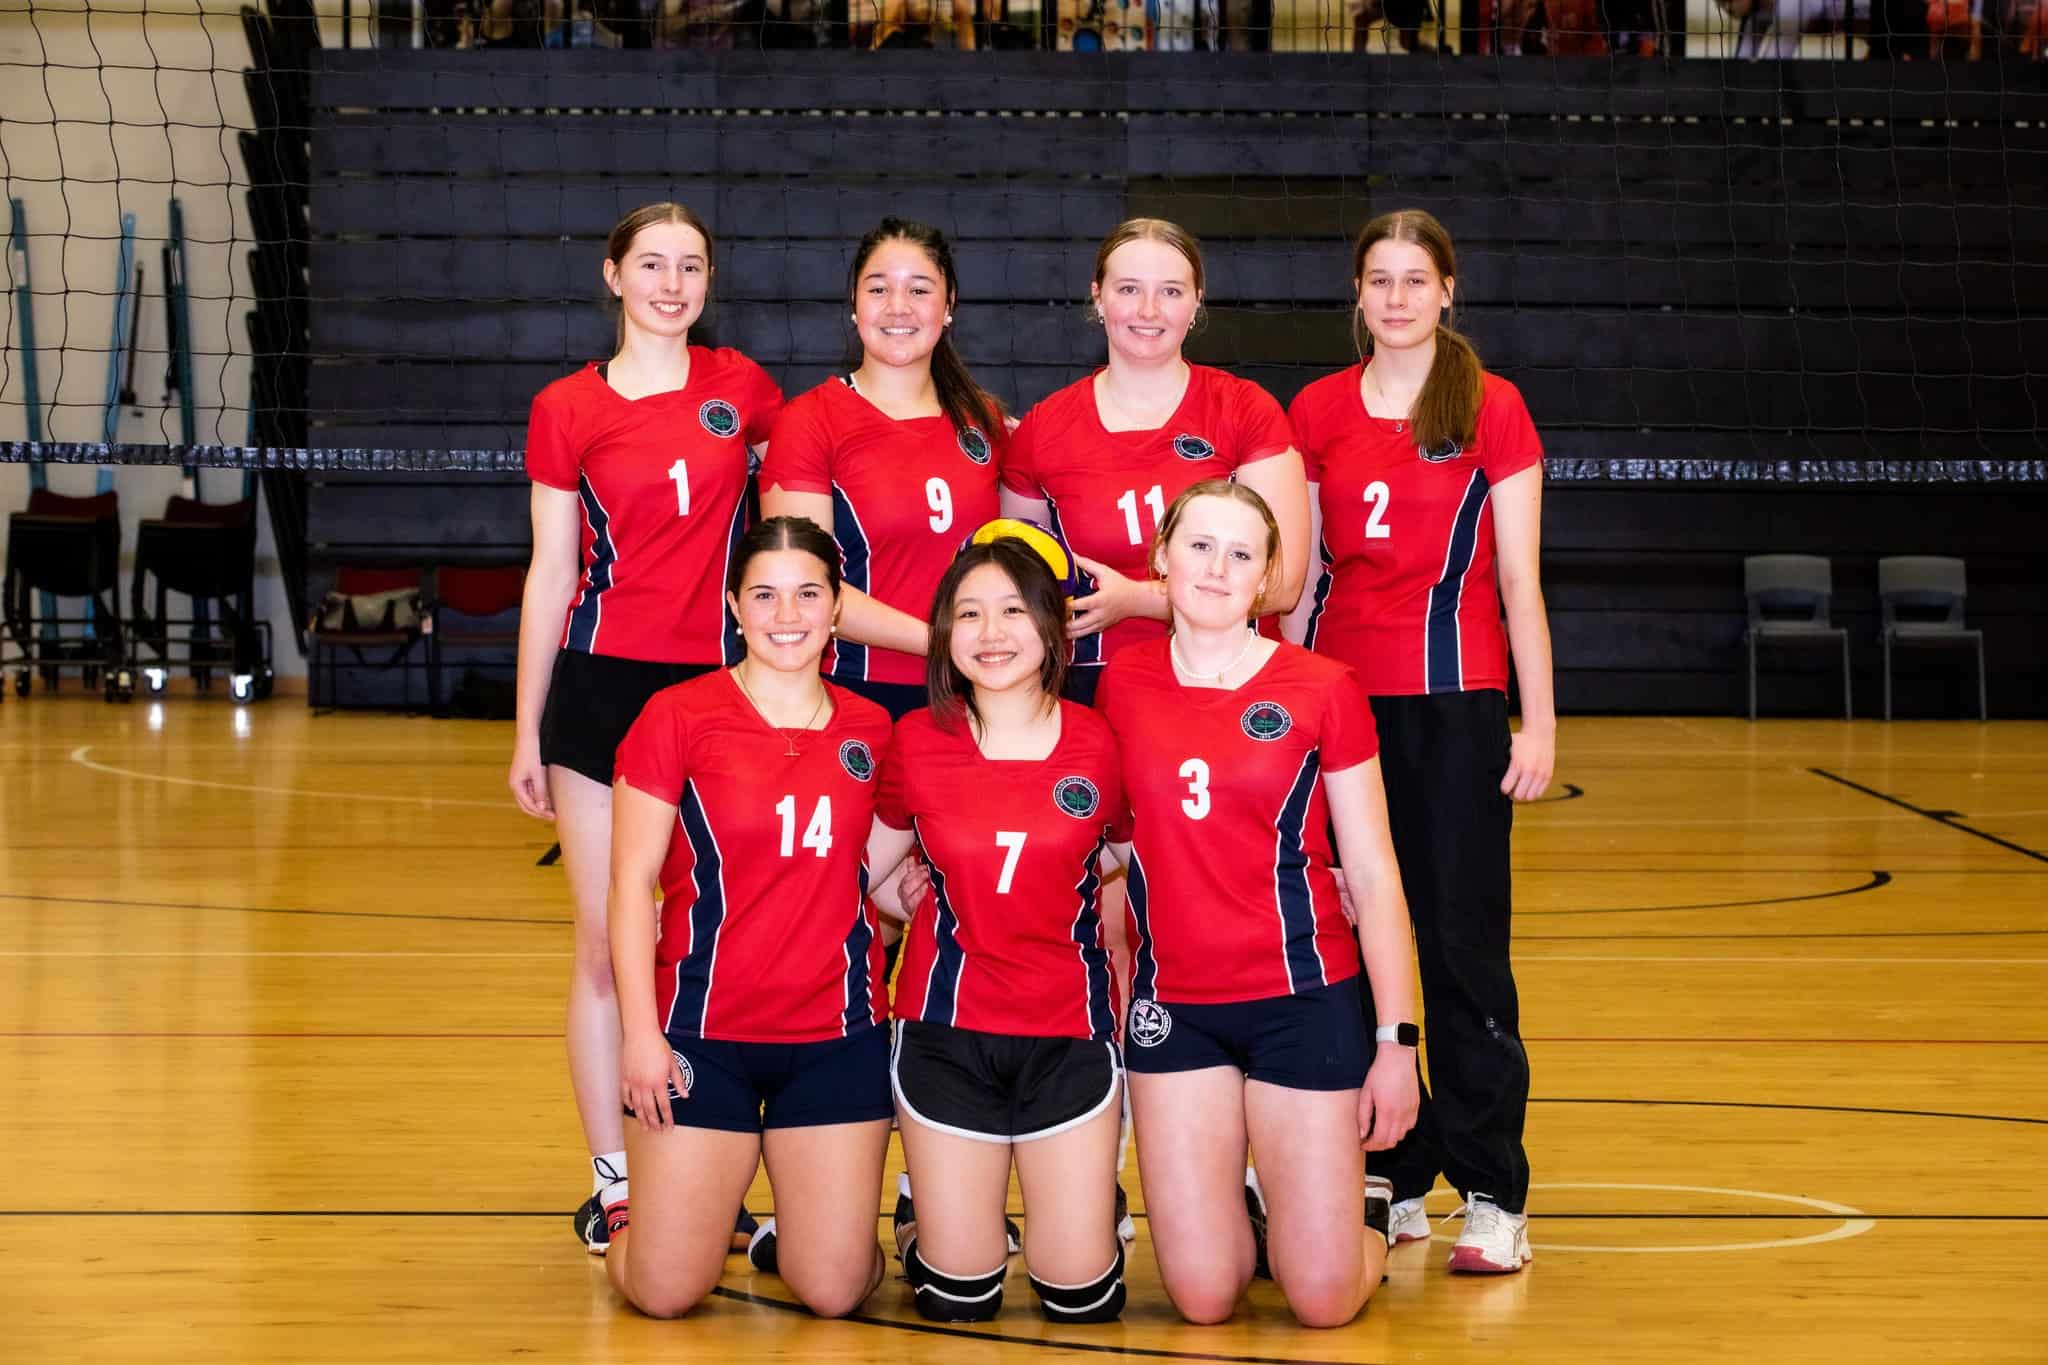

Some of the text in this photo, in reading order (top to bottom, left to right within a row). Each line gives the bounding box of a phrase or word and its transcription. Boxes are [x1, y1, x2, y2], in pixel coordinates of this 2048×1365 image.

[668, 459, 690, 516] 1
[925, 477, 953, 533] 9
[1117, 485, 1165, 545] 11
[1363, 481, 1390, 538] 2
[1179, 758, 1211, 820] 3
[775, 795, 833, 857] 14
[996, 831, 1028, 894] 7
